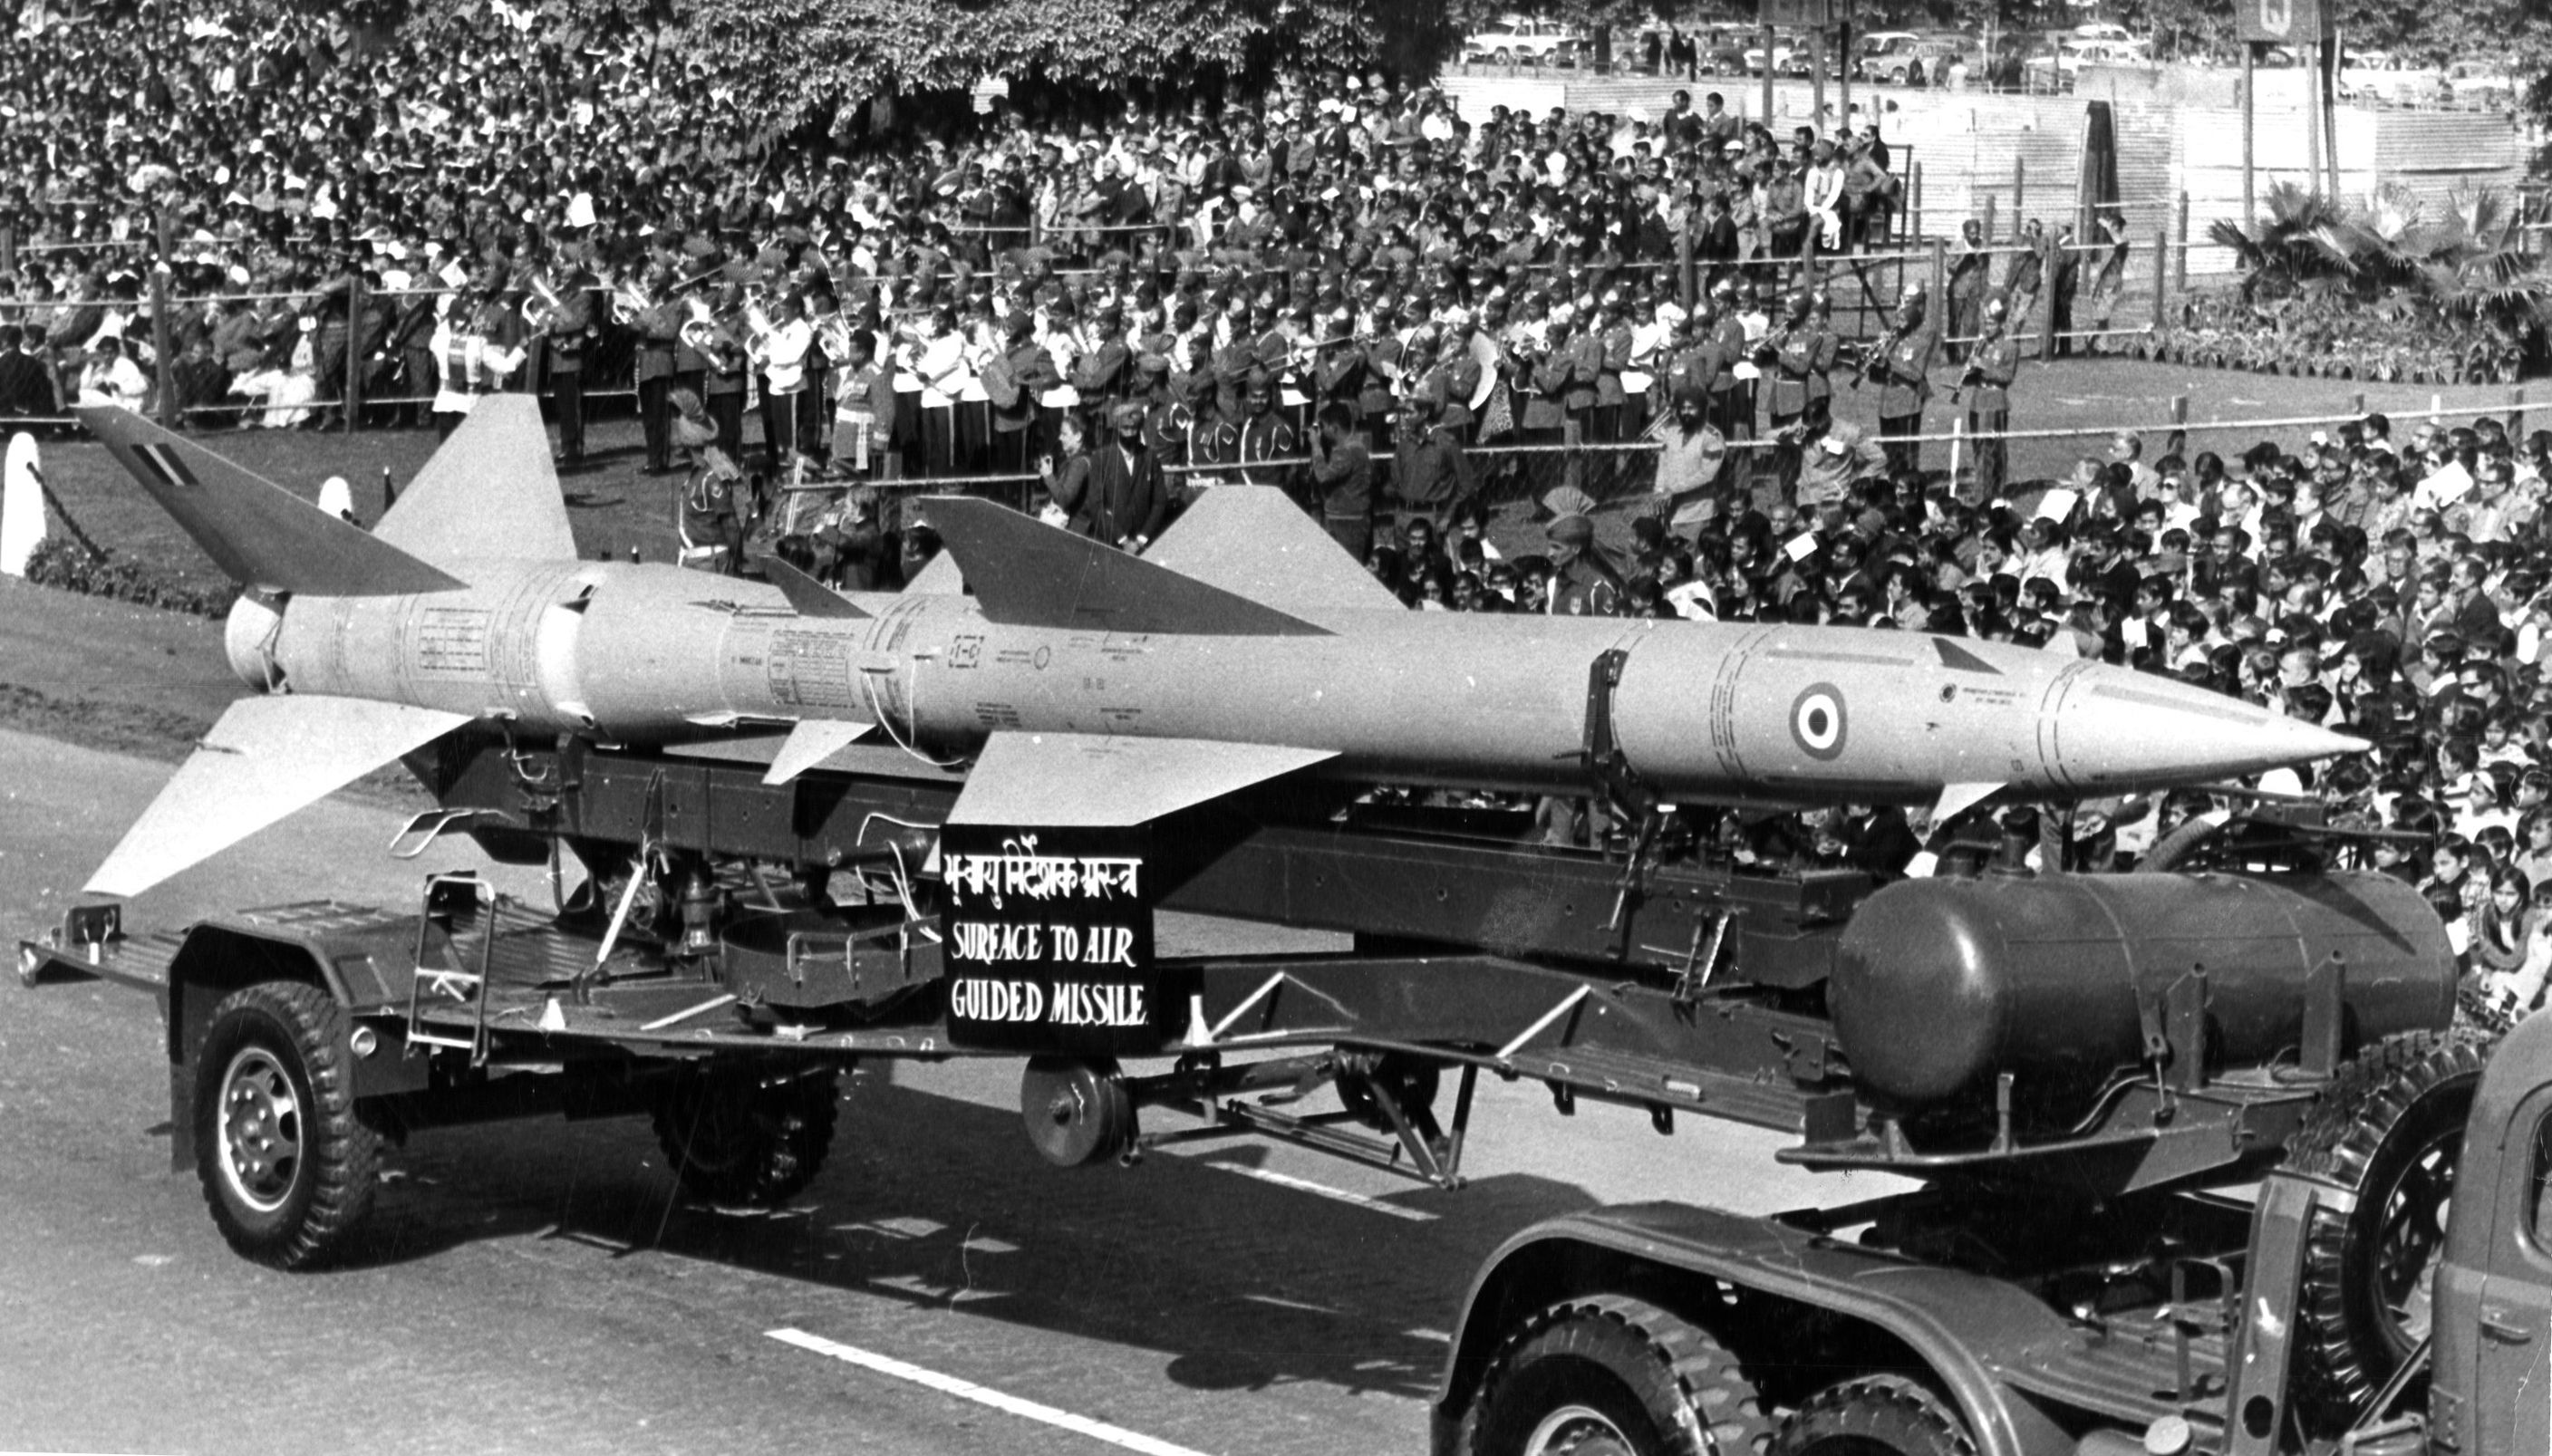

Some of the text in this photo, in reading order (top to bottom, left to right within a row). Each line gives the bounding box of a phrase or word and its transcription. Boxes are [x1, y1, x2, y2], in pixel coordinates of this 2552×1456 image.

[952, 921, 1137, 968] SURFACE TO AIR
[952, 979, 1043, 1022] GUIDED
